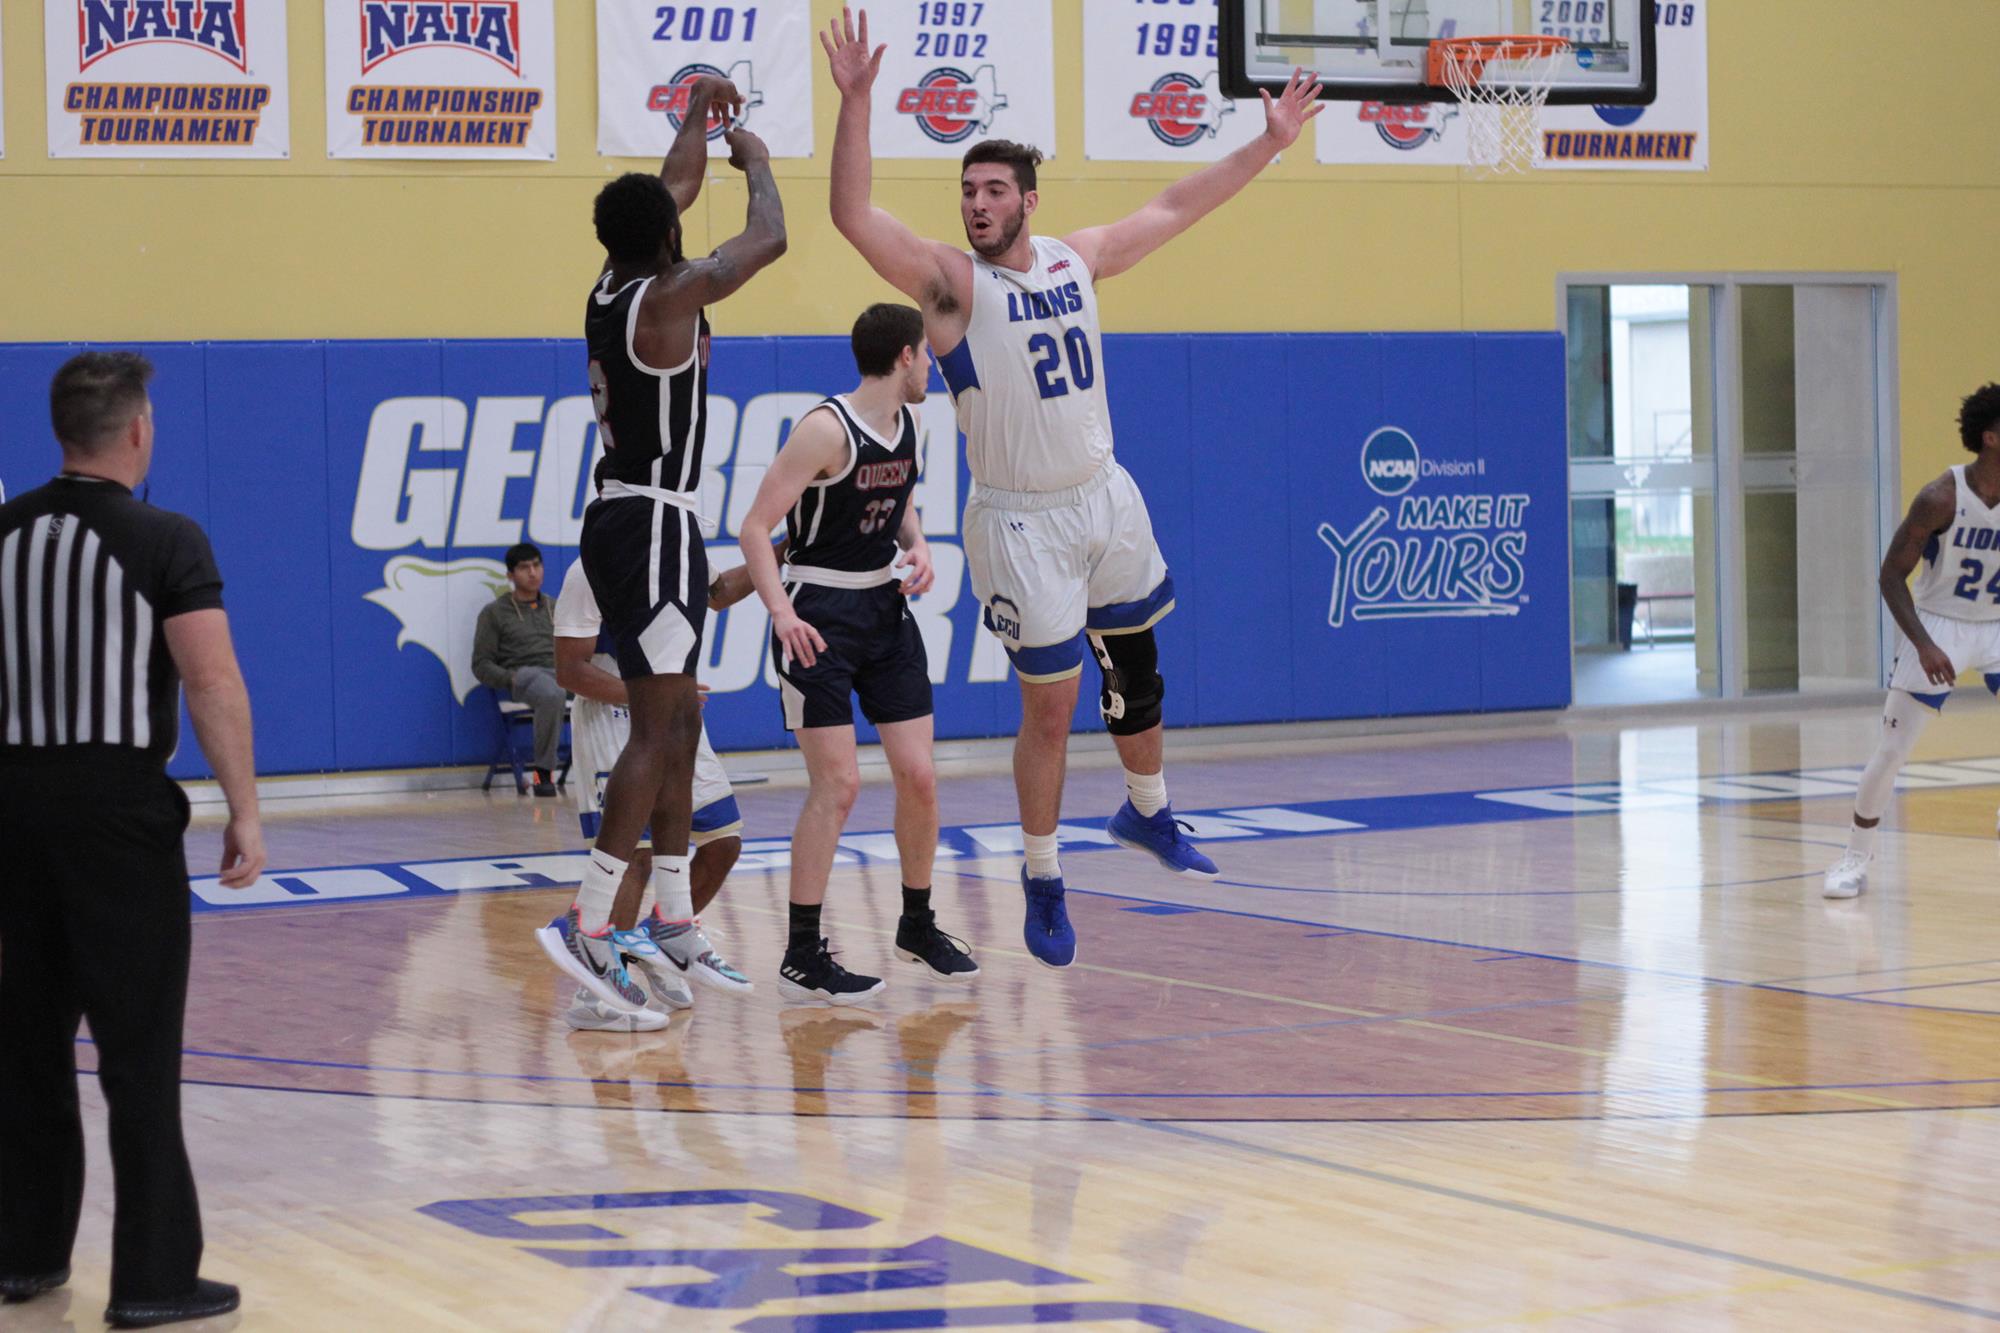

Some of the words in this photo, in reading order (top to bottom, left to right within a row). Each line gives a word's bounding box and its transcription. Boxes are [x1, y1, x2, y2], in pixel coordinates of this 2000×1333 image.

[652, 6, 757, 42] 2001
[918, 1, 985, 26] 1997
[1540, 0, 1605, 24] 2008
[84, 0, 241, 60] NAIA
[365, 4, 515, 64] NAIA
[914, 33, 988, 58] 2002
[67, 86, 268, 111] CHAMPIONSHIP
[349, 88, 541, 114] CHAMPIONSHIP
[897, 88, 978, 114] CACC
[1129, 93, 1207, 118] CACC
[83, 118, 257, 142] TOURNAMENT
[365, 120, 529, 144] TOURNAMENT
[1544, 133, 1697, 158] TOURNAMENT
[1007, 280, 1083, 322] LIONS
[1028, 326, 1094, 399] 20
[1369, 460, 1418, 479] NCAA
[1421, 459, 1475, 476] Division
[1397, 495, 1492, 530] MAKE
[1495, 494, 1531, 528] IT
[1317, 506, 1528, 628] YOURS
